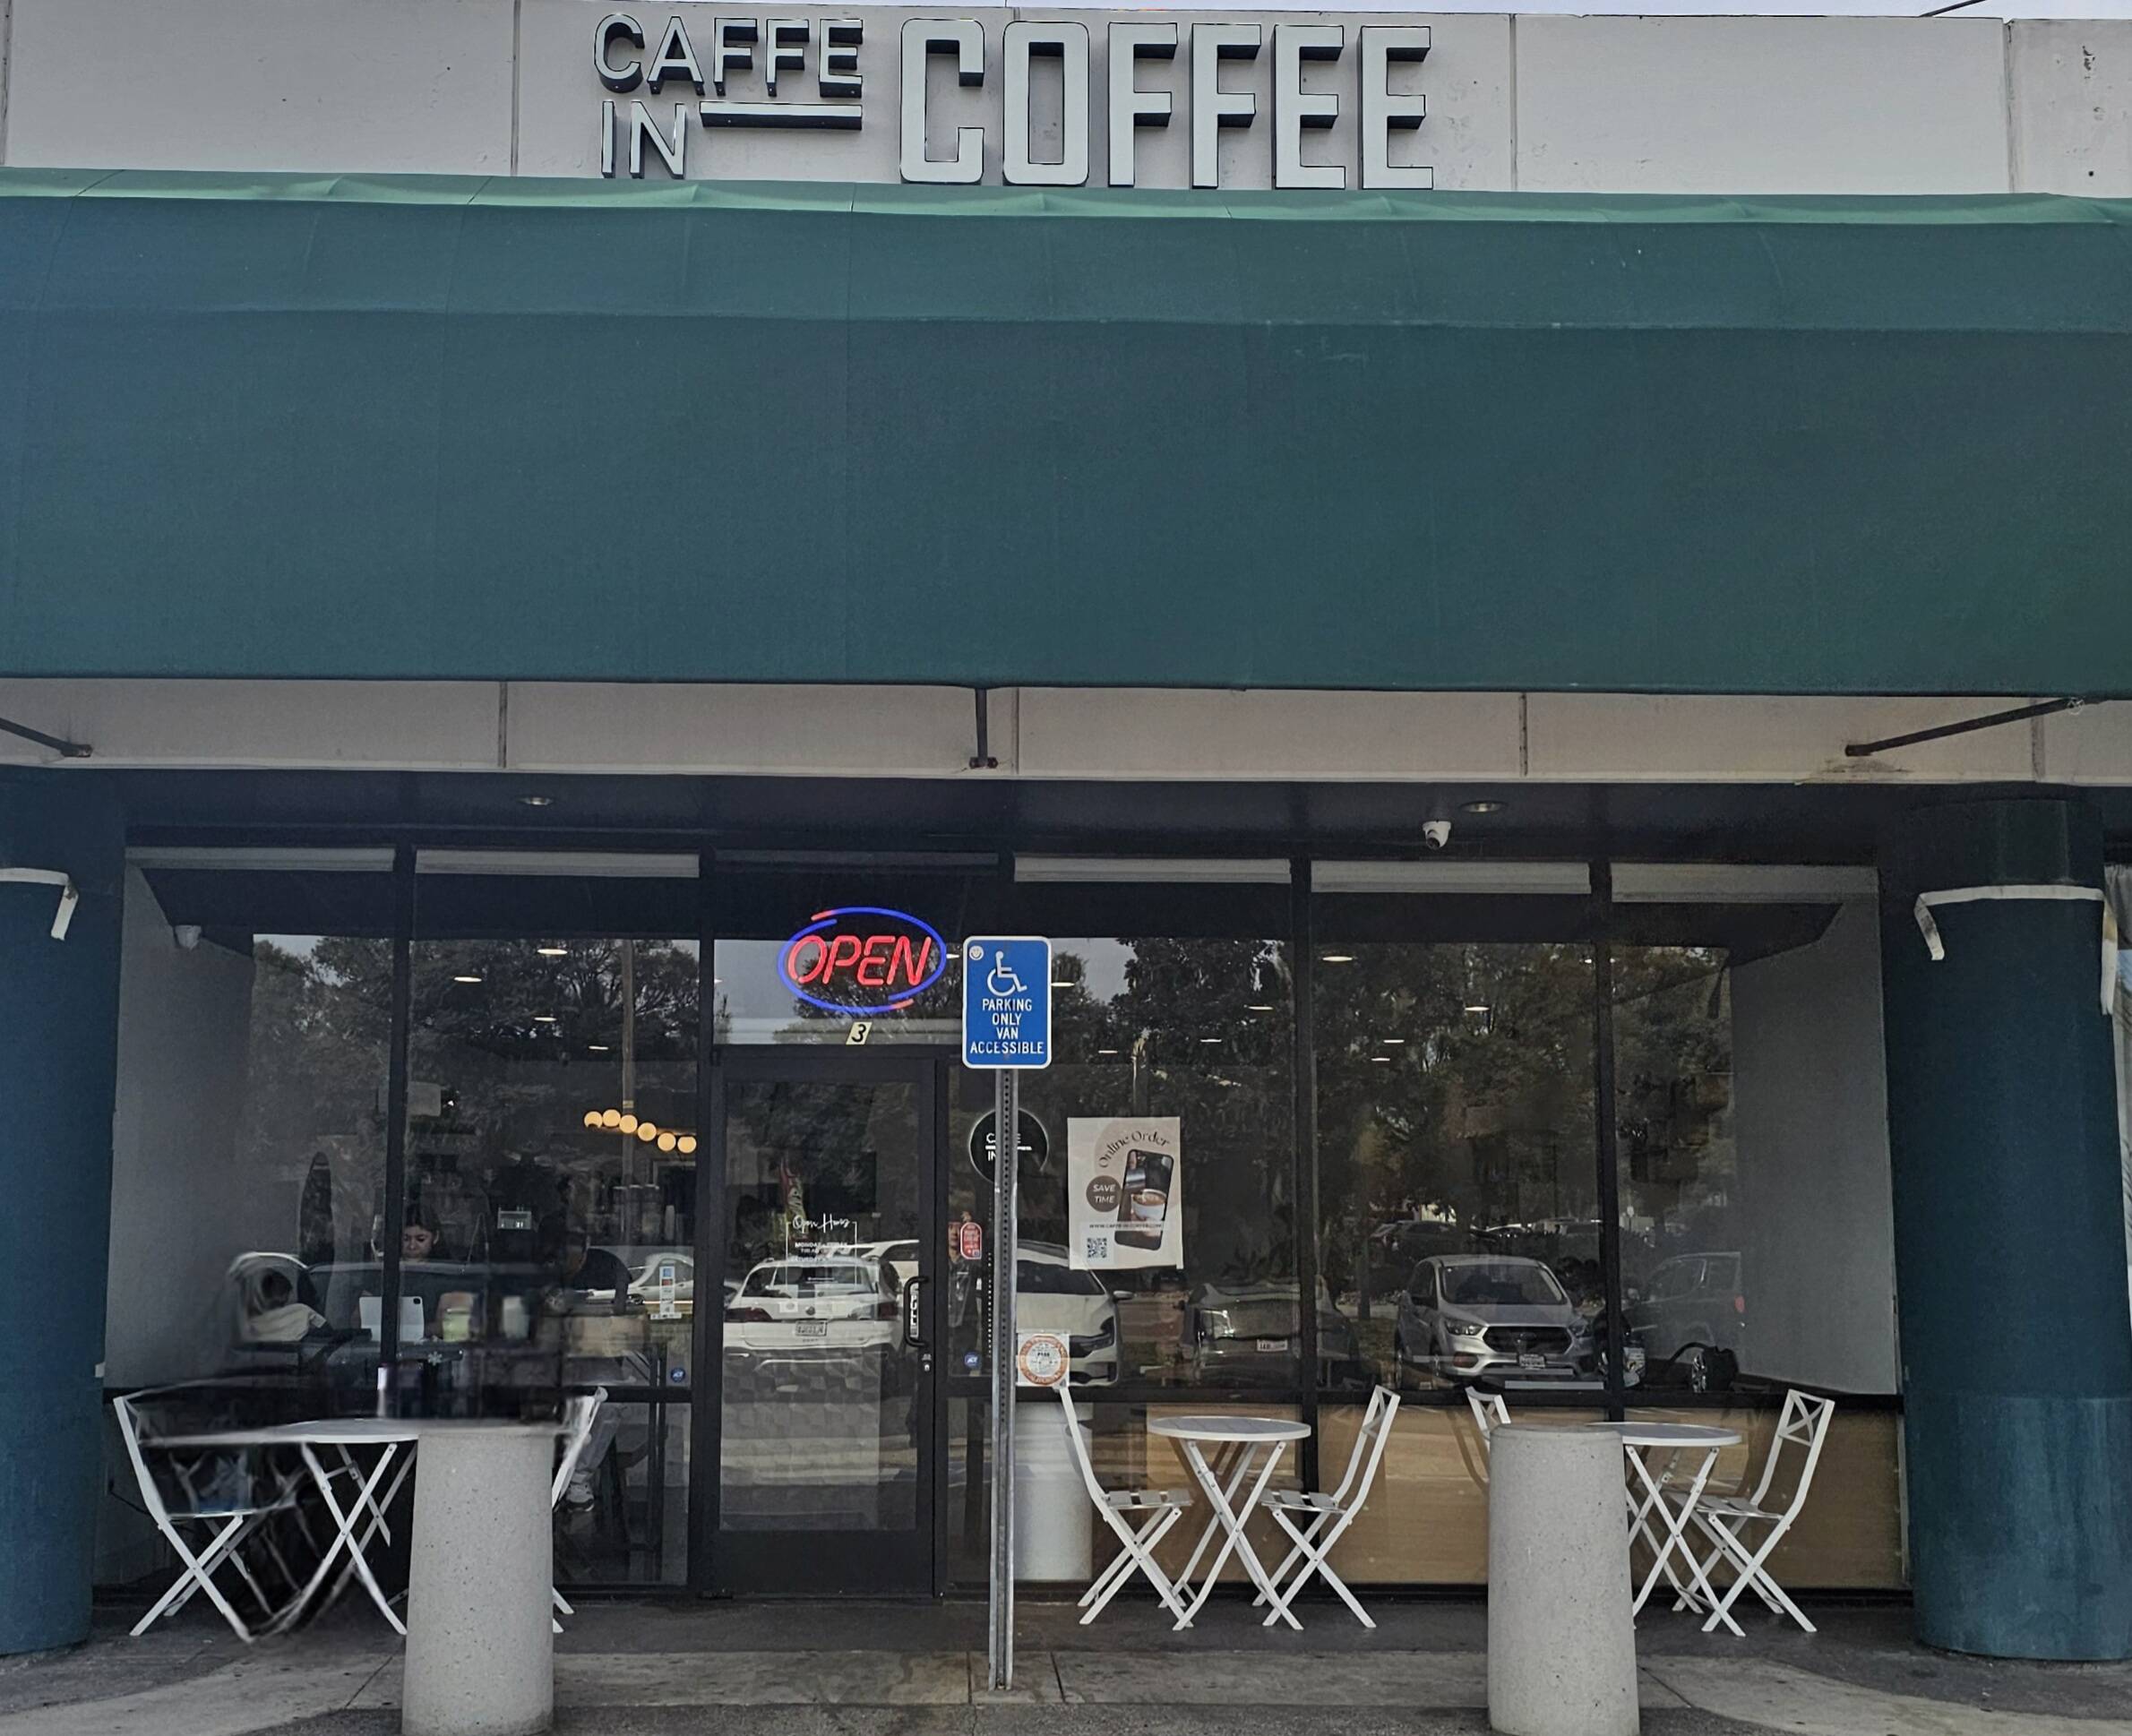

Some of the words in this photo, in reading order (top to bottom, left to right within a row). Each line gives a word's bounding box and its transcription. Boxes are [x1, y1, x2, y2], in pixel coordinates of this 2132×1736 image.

[594, 13, 864, 98] CAFFE
[900, 18, 1433, 190] COFFEE
[601, 99, 686, 179] IN
[787, 934, 932, 985] OPEN
[982, 998, 1032, 1011] PARKING
[992, 1012, 1022, 1026] ONLY
[850, 1024, 866, 1043] 3
[996, 1027, 1019, 1040] VAN
[969, 1041, 1045, 1054] ACCESSIBLE
[1098, 1136, 1129, 1168] Online
[1131, 1130, 1171, 1147] Order
[1093, 1183, 1116, 1192] SAVE
[1095, 1195, 1115, 1204] TIME
